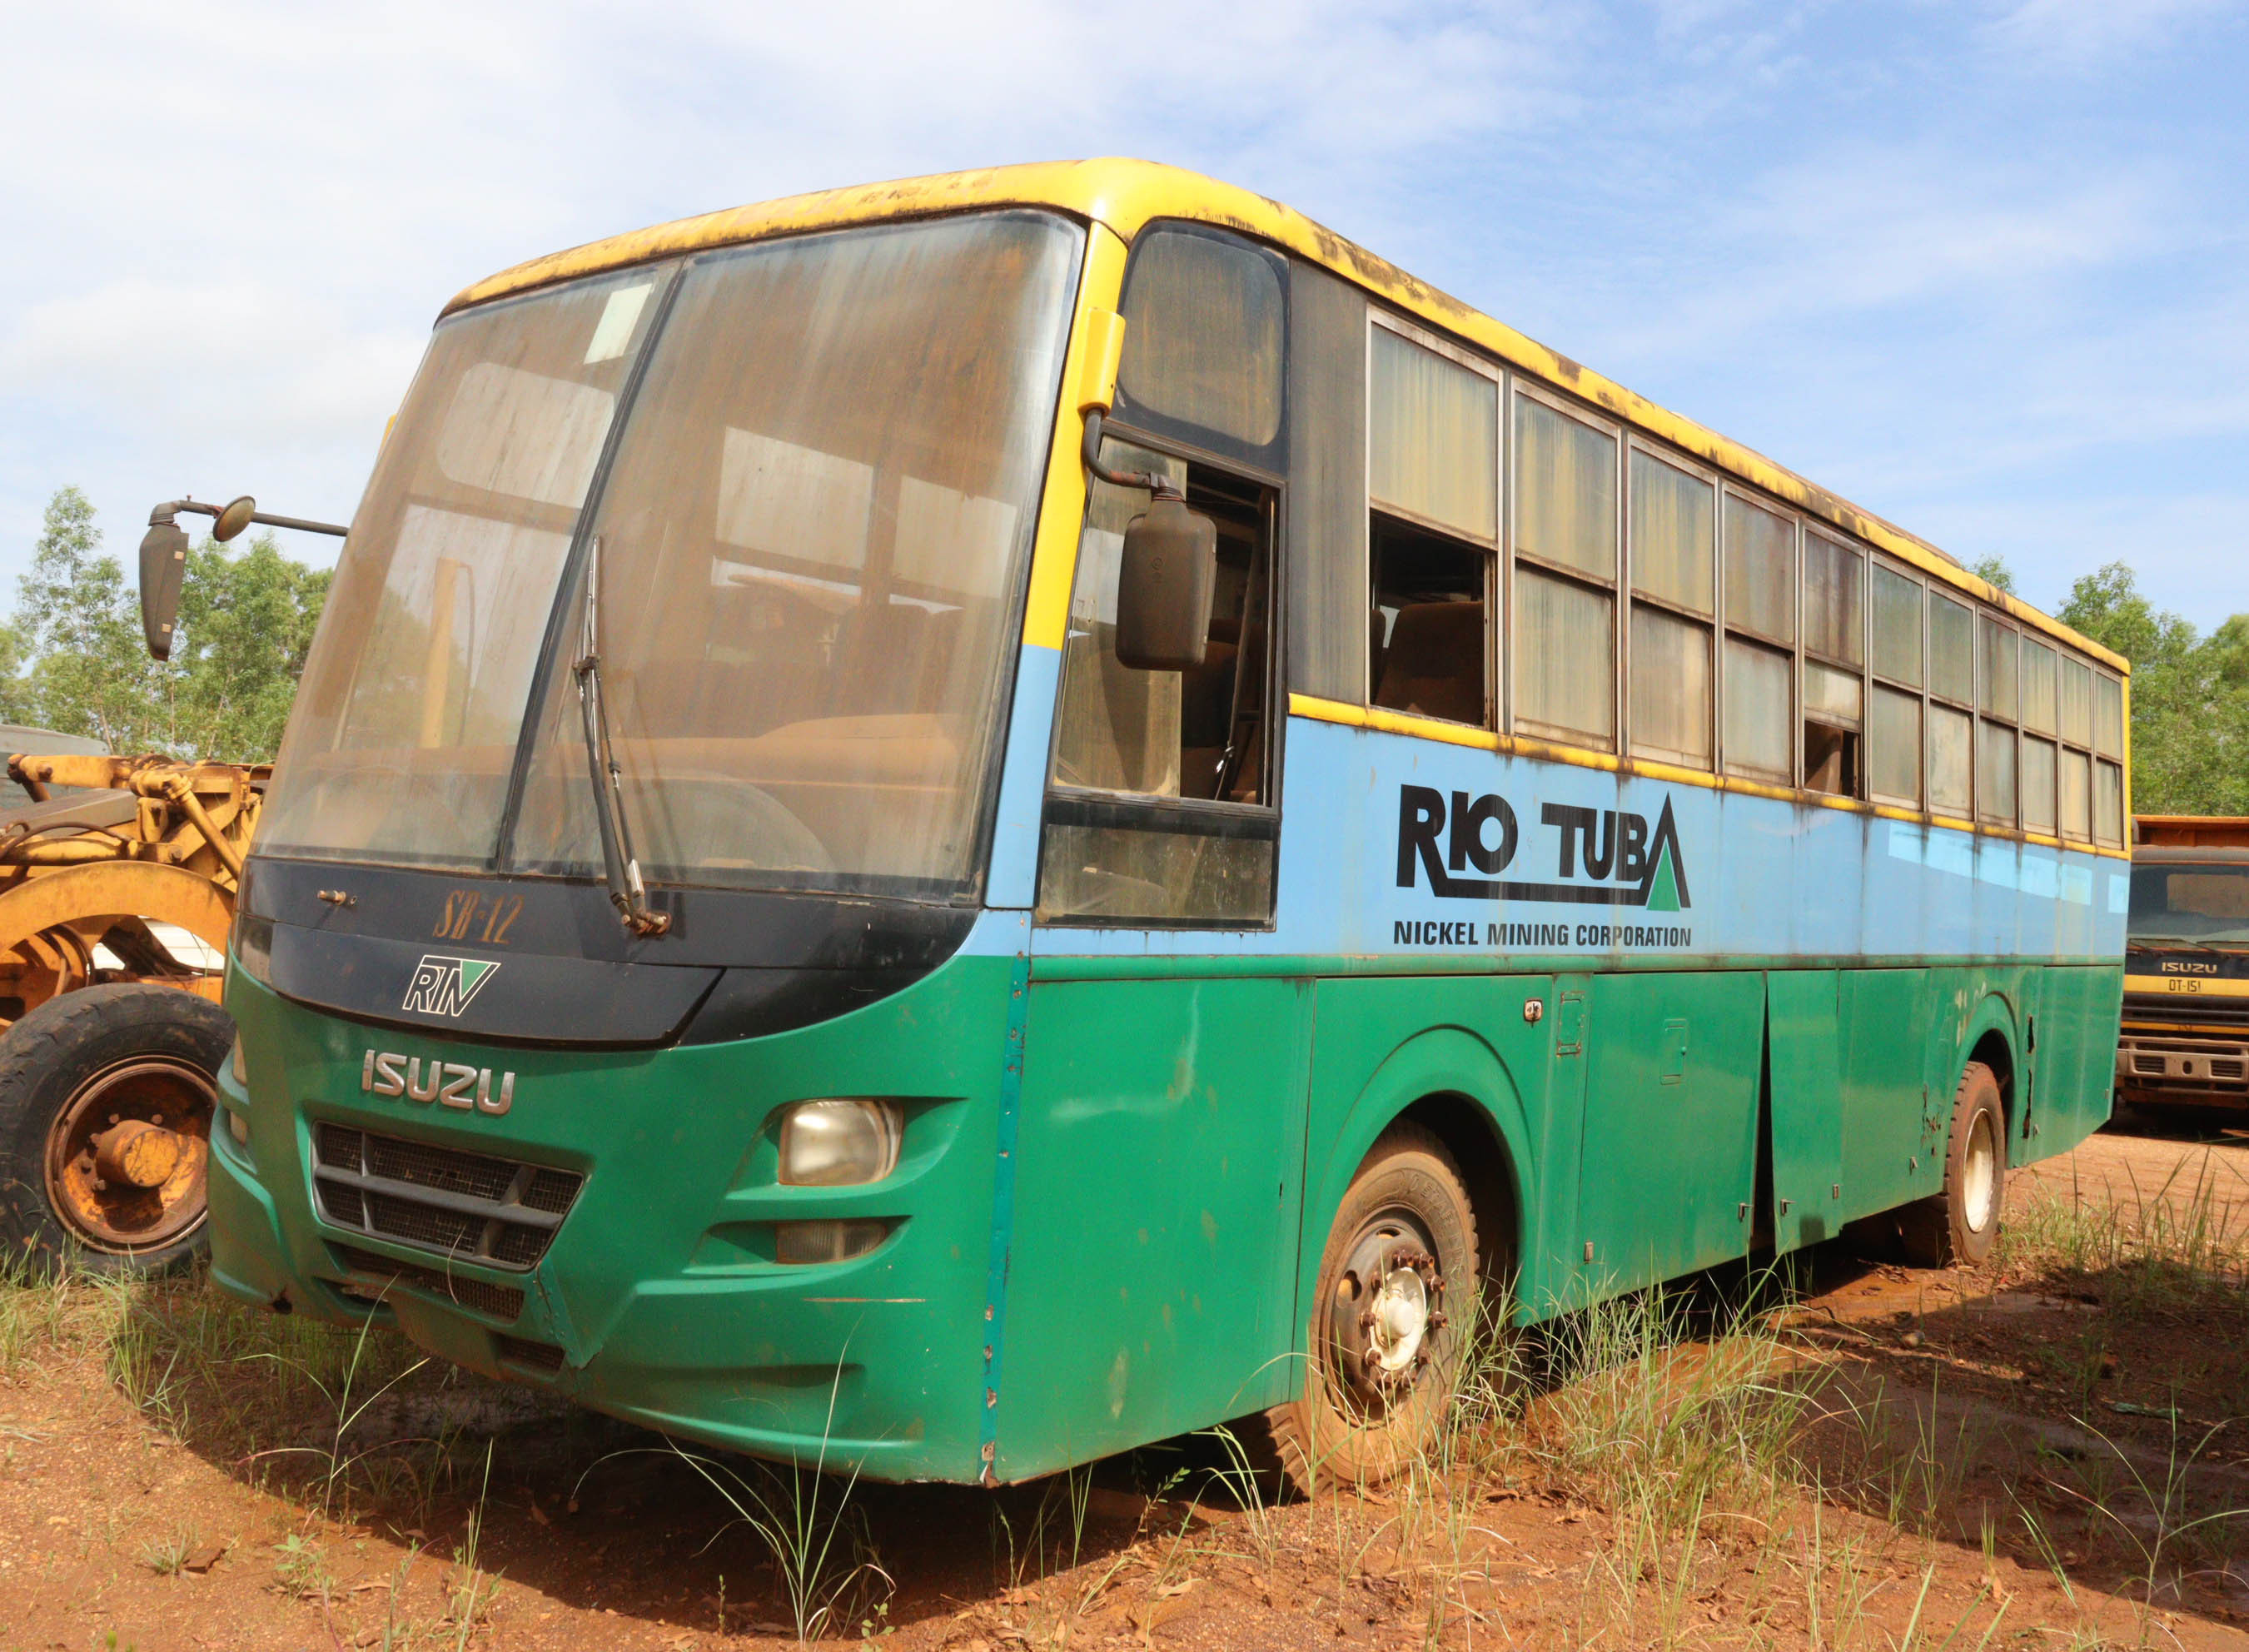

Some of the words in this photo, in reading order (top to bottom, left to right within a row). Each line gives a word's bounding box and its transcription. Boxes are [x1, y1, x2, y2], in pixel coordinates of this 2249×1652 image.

[1396, 784, 1519, 898] RIO
[1540, 790, 1692, 912] TUBA
[432, 889, 525, 945] SB-12
[1393, 920, 1479, 946] NICKEL
[1486, 922, 1570, 947] MINING
[1575, 924, 1692, 948] CORPORATION
[2162, 962, 2217, 974] ISUZU
[361, 1049, 515, 1115] ISUZU
